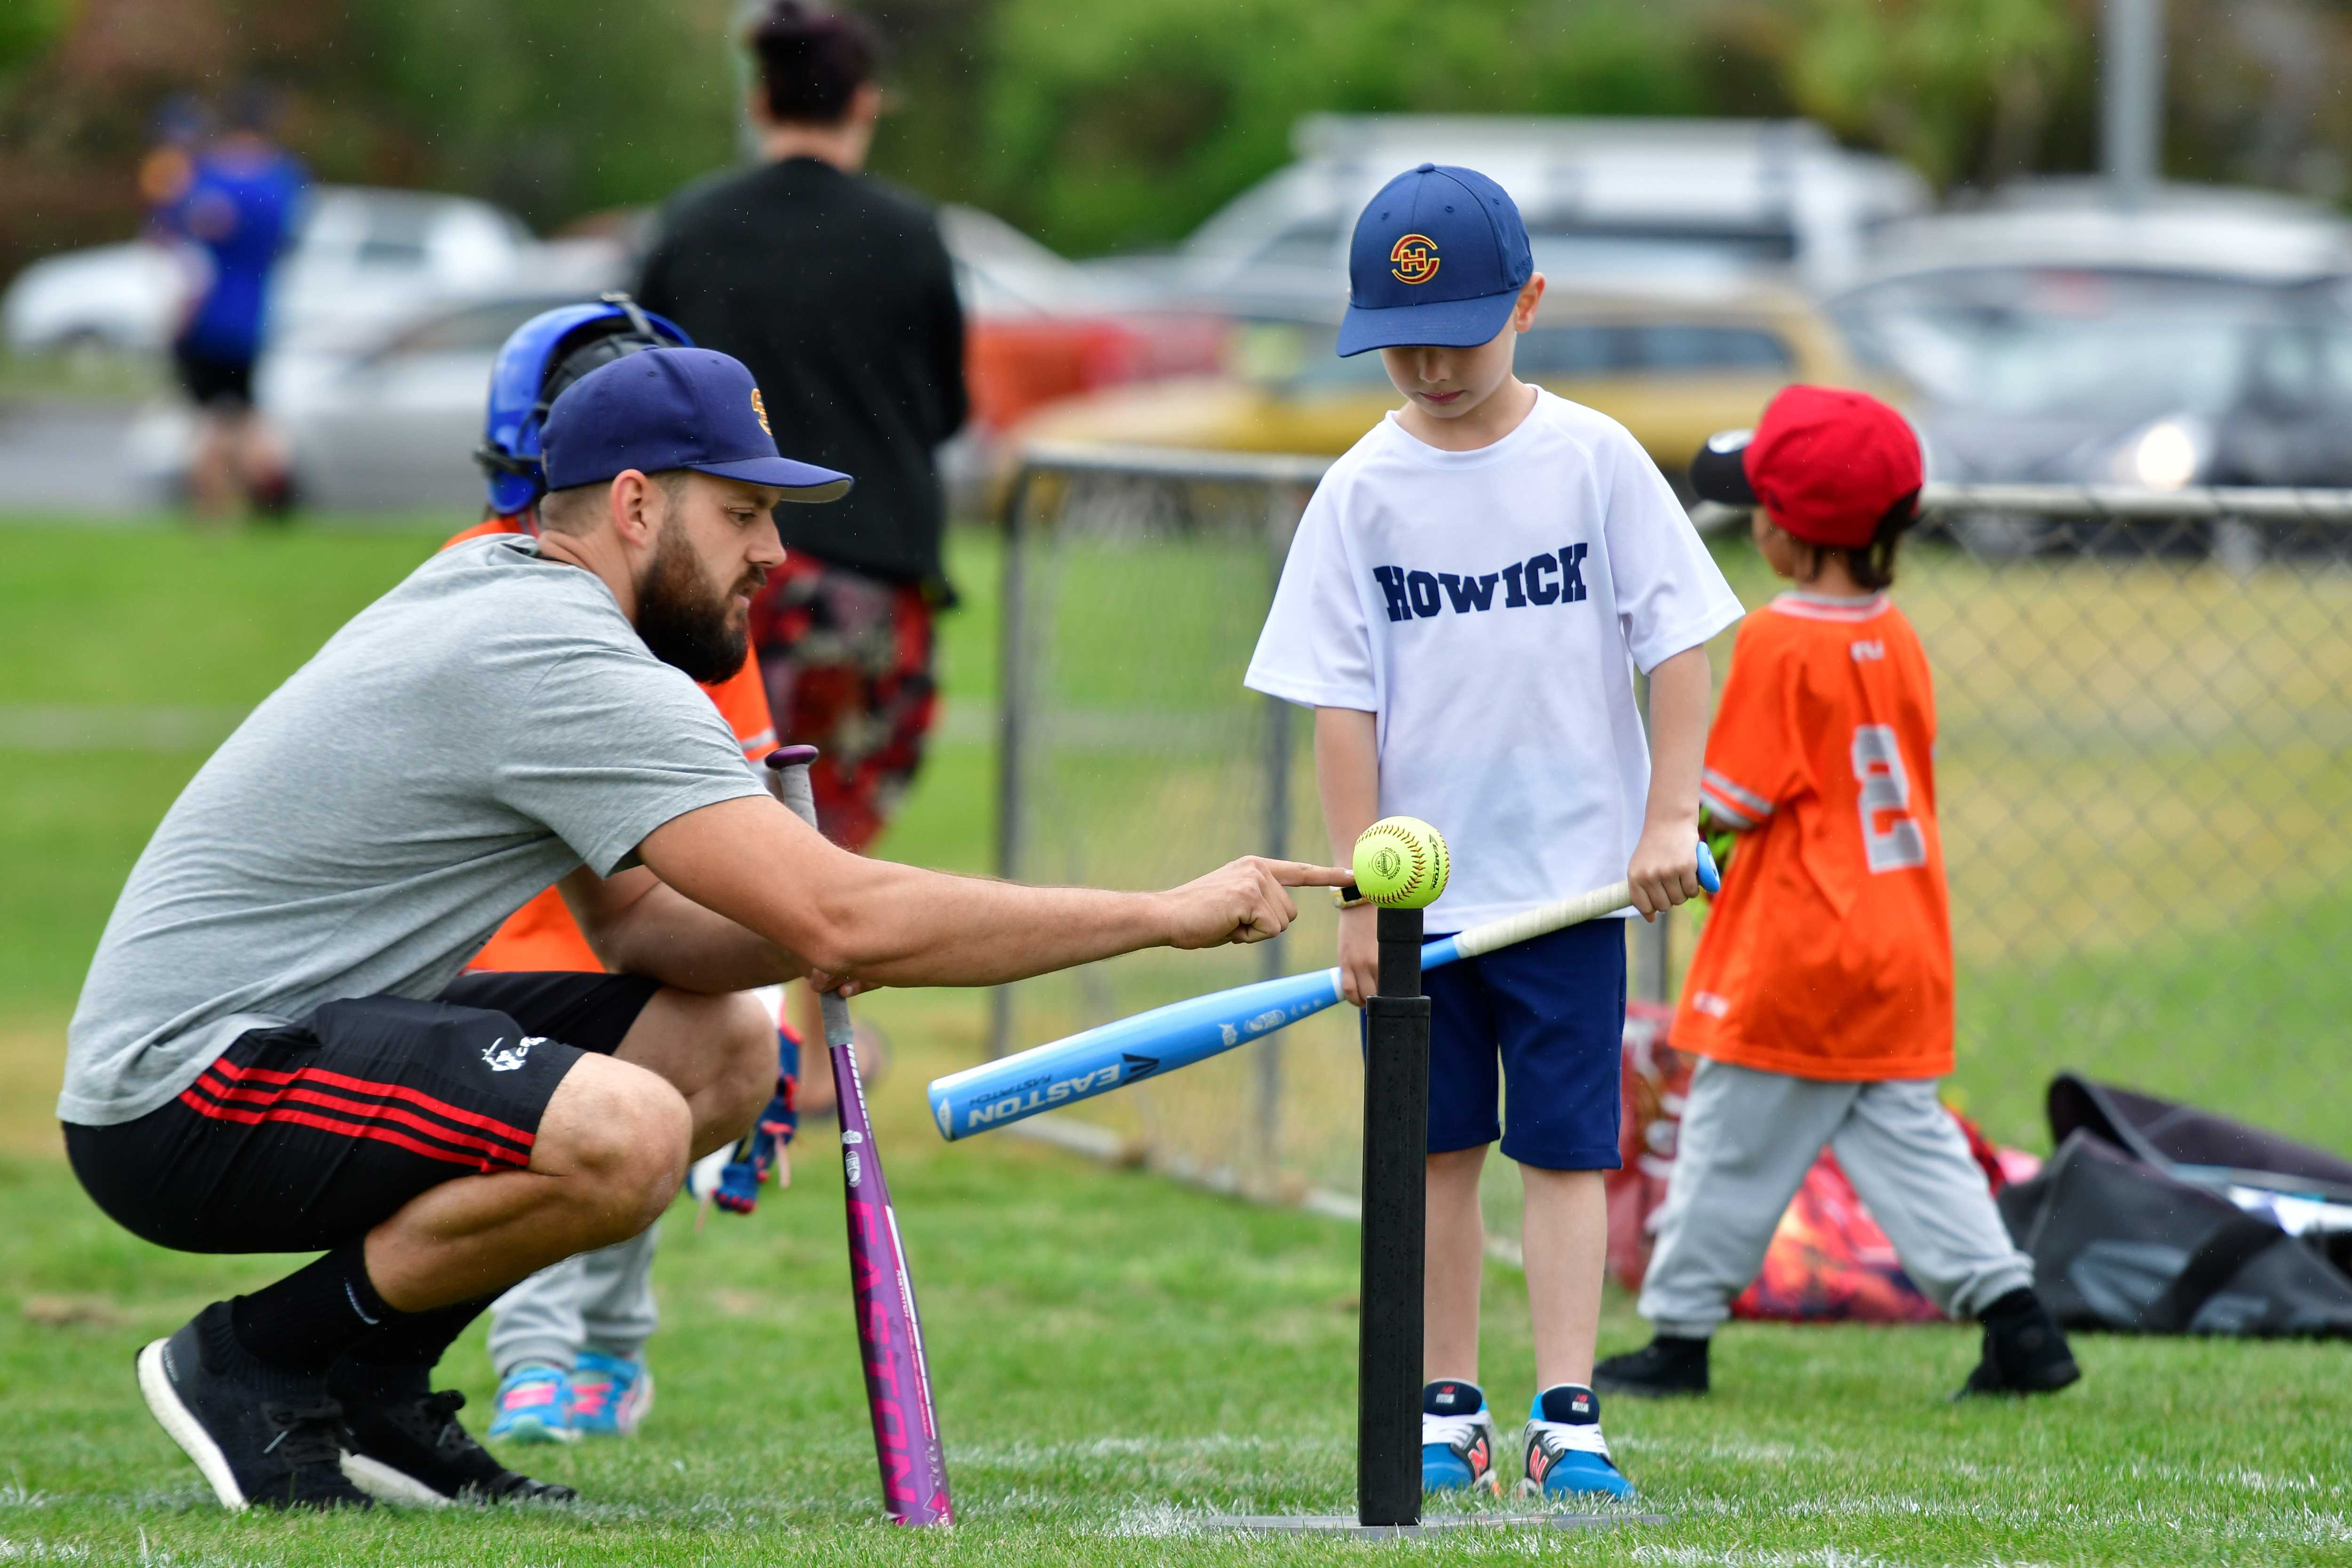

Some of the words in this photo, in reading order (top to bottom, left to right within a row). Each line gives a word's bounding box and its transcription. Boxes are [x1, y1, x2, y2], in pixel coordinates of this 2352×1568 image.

[1372, 542, 1588, 622] HOWICK
[1851, 724, 1926, 874] 2
[968, 1063, 1120, 1128] EASTON
[848, 1198, 916, 1504] EASTON
